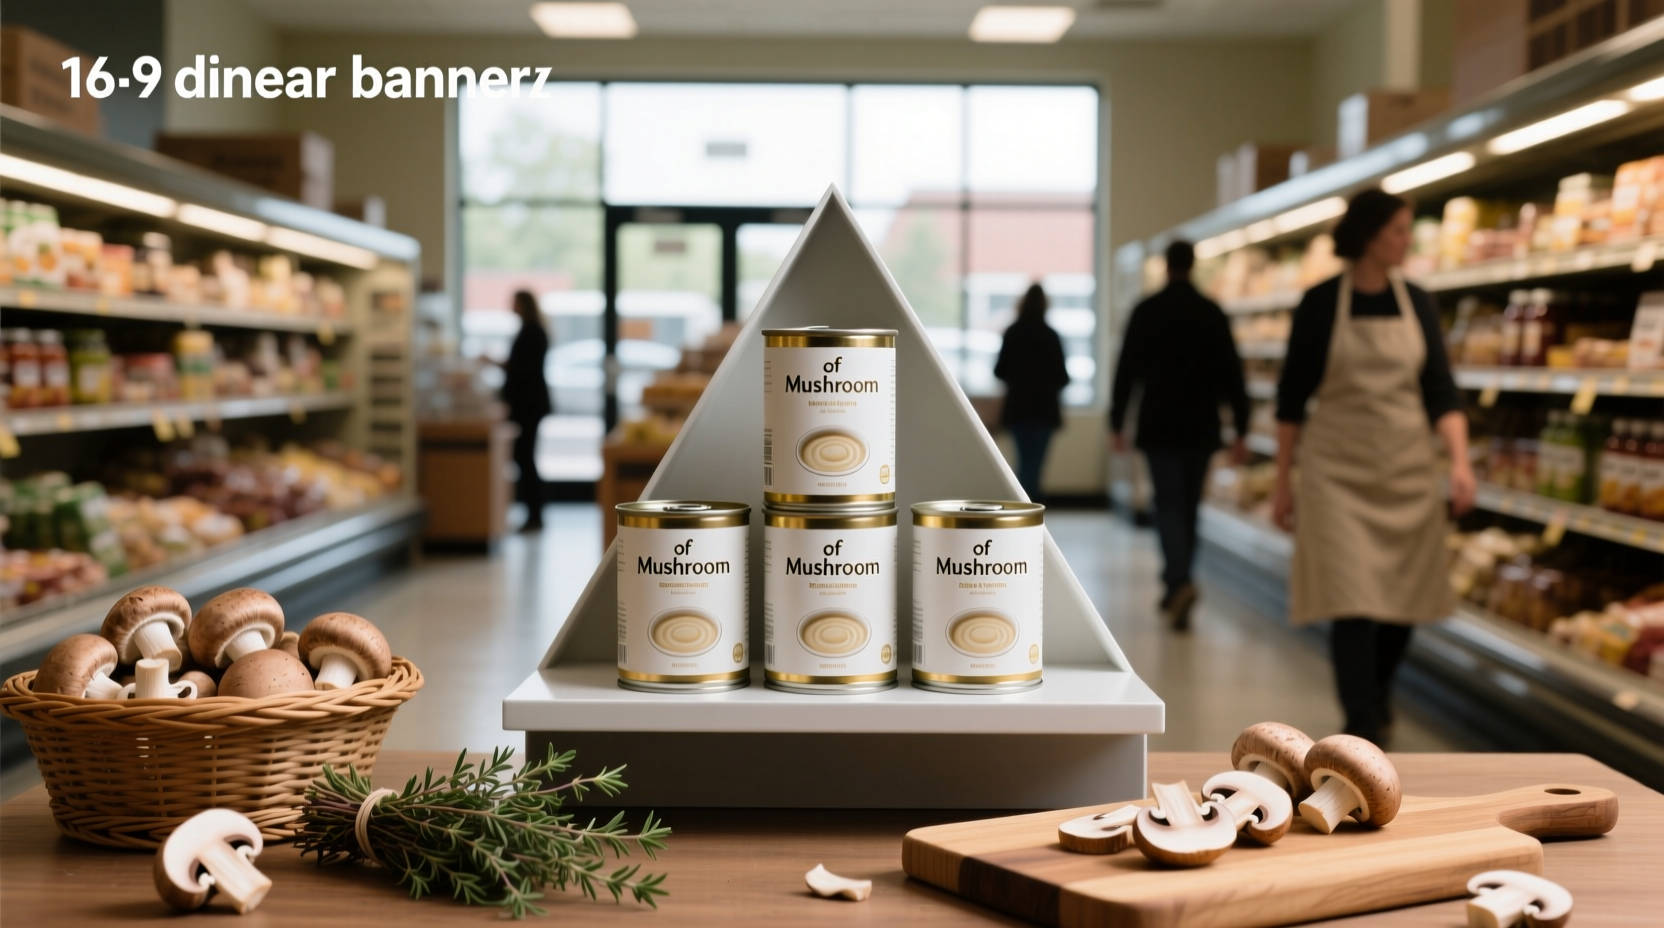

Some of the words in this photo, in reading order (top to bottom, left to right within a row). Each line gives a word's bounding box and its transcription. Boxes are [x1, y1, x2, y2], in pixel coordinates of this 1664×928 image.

[823, 356, 843, 373] of
[785, 374, 879, 394] Mushroom
[674, 539, 693, 556] of
[823, 539, 843, 556] of
[973, 539, 992, 556] of
[637, 556, 730, 575] Mushroom
[786, 557, 880, 576] Mushroom
[936, 556, 1028, 575] Mushroom
